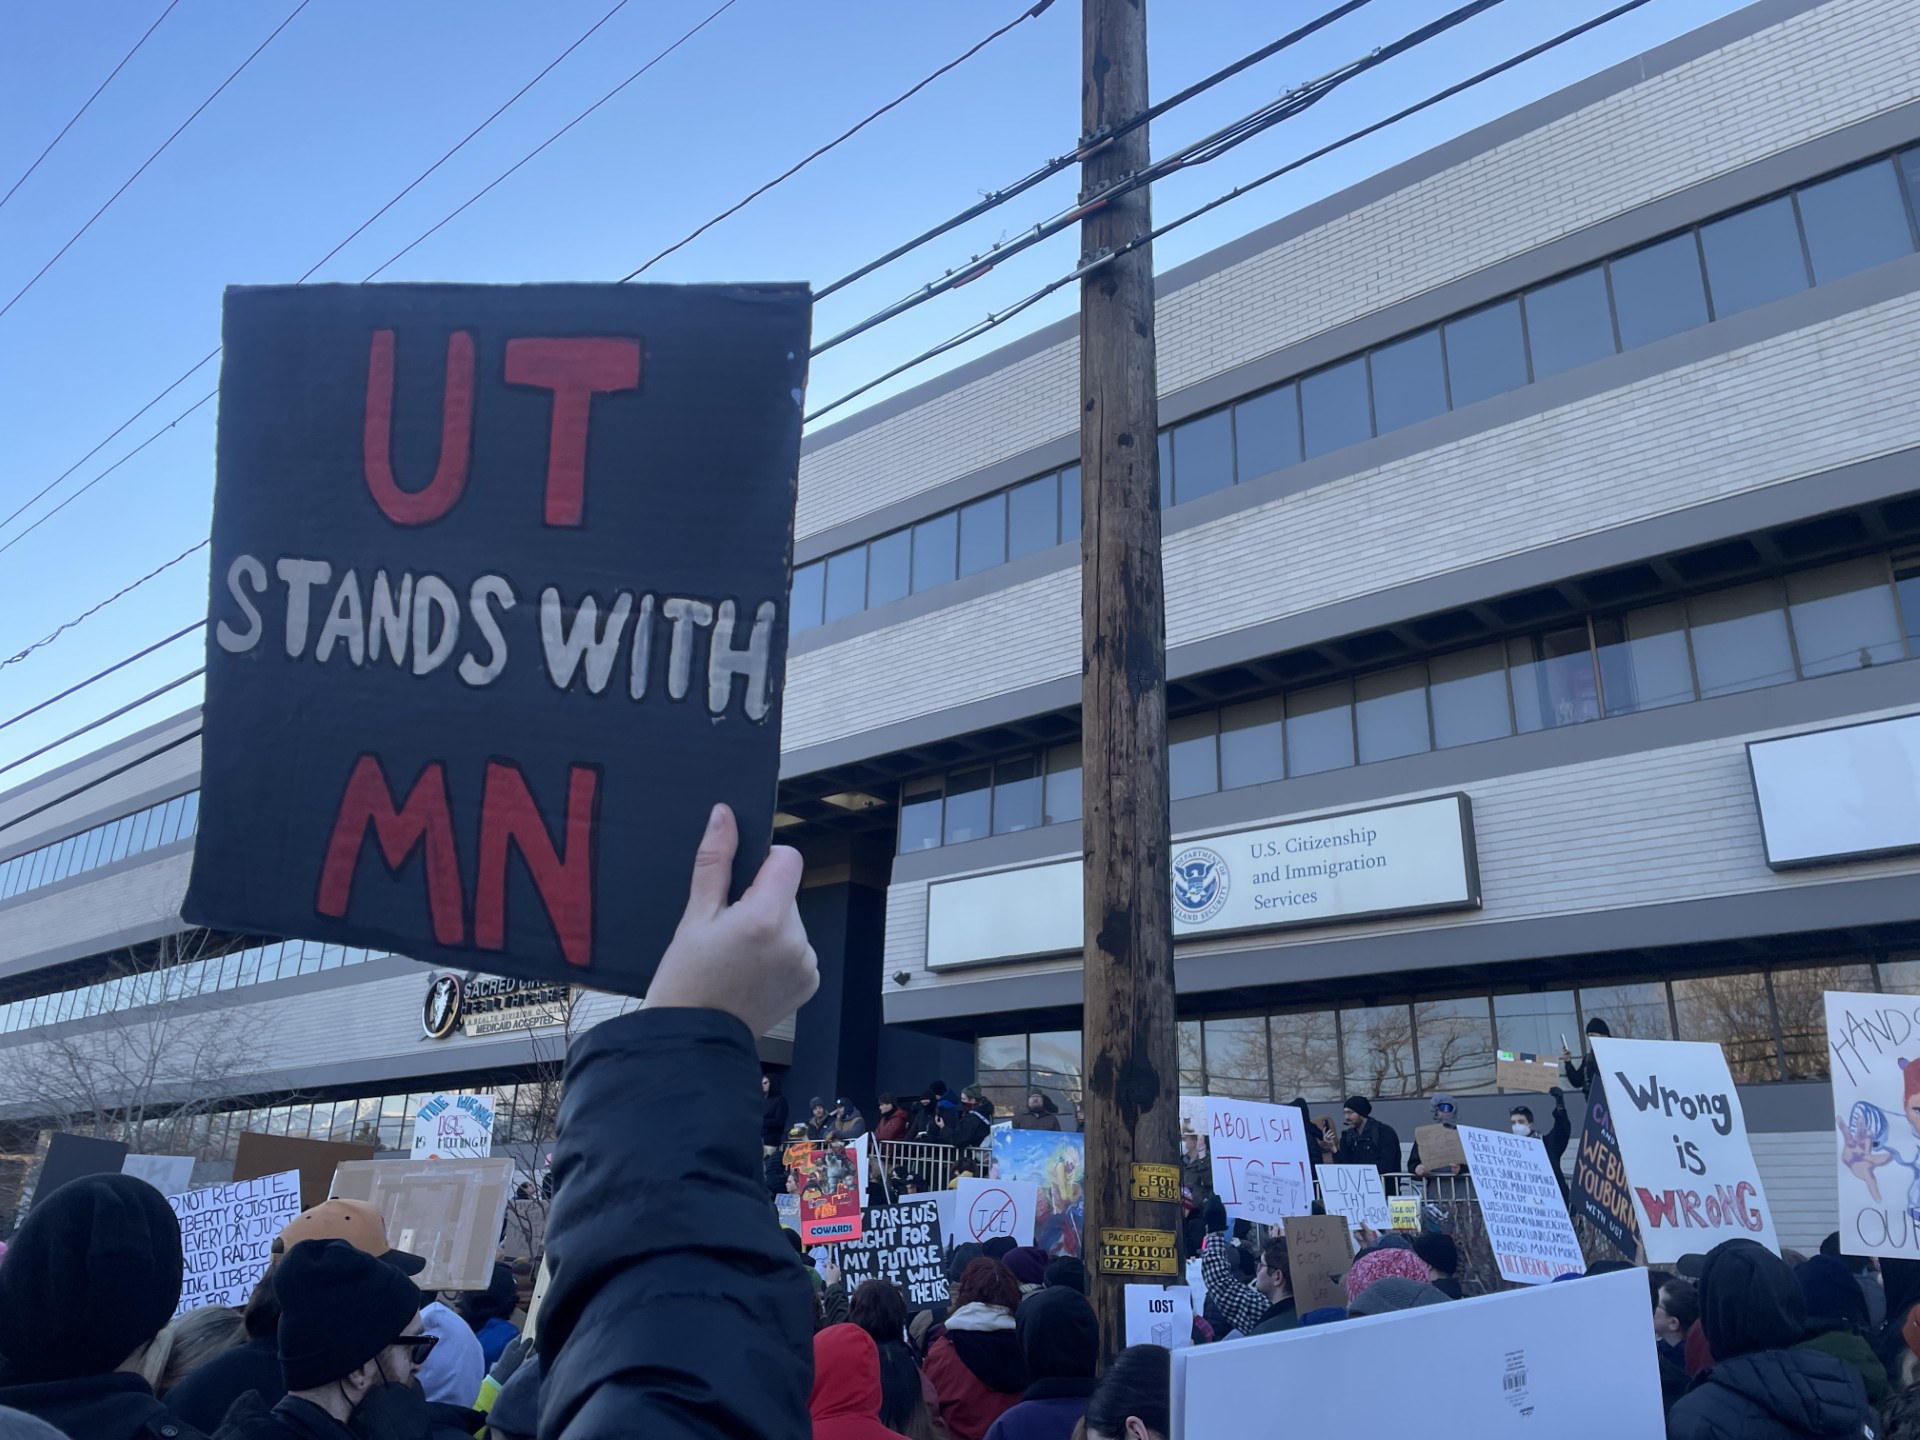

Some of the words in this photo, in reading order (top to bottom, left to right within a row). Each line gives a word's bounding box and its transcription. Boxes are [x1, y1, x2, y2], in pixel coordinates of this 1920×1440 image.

[362, 327, 642, 526] UT
[215, 553, 517, 686] STANDS
[540, 585, 776, 723] WITH
[1250, 841, 1281, 859] U.S.
[1285, 827, 1377, 853] Citizenship
[315, 754, 597, 967] MN
[1175, 850, 1221, 866] DEPARTMENT
[1218, 866, 1227, 877] OF
[1252, 866, 1280, 884] and
[1285, 854, 1387, 879] Immigration
[1201, 886, 1227, 919] SECURITY
[1254, 890, 1318, 910] Services
[463, 977, 516, 1000] SACRED
[475, 1020, 512, 1034] MEDICAID
[513, 1015, 554, 1029] ACCEPTED
[1831, 1007, 1920, 1087] HAND
[416, 1094, 450, 1122] THE
[456, 1095, 494, 1129] WRONG
[1613, 1071, 1732, 1136] Wrong
[1213, 1111, 1293, 1142] ABOLISH
[1467, 1131, 1489, 1143] ALEX
[1497, 1135, 1534, 1151] PRETTI
[1499, 1147, 1522, 1159] GOOD
[1473, 1153, 1504, 1166] KEITH
[1506, 1157, 1540, 1172] PORTER
[1672, 1134, 1706, 1176] is
[182, 1190, 205, 1213] NOT
[212, 1173, 289, 1204] RECITE
[1140, 1186, 1150, 1197] 3
[1318, 1167, 1381, 1194] LOVE
[1476, 1177, 1509, 1192] VICTOR
[178, 1205, 230, 1234] IBERTY
[233, 1203, 244, 1224] &
[244, 1191, 300, 1220] JUSTICE
[1339, 1192, 1366, 1208] THY
[811, 1223, 852, 1235] COWARDS
[871, 1202, 937, 1229] PARENTS
[976, 1208, 1009, 1233] ICE
[1585, 1200, 1606, 1223] WITH
[1609, 1220, 1623, 1240] US!
[185, 1226, 223, 1253] EVERY
[225, 1219, 251, 1244] DAY
[901, 1223, 932, 1246] FOR
[1490, 1224, 1526, 1239] GERALDO
[183, 1251, 219, 1275] ALLED
[843, 1251, 870, 1271] MY
[877, 1244, 942, 1271] FUTURE
[1104, 1245, 1175, 1259] 11401001
[213, 1261, 271, 1290] LIBERT
[907, 1265, 944, 1284] WILL
[908, 1279, 950, 1305] THEIRS
[1148, 1299, 1175, 1315] LOST
